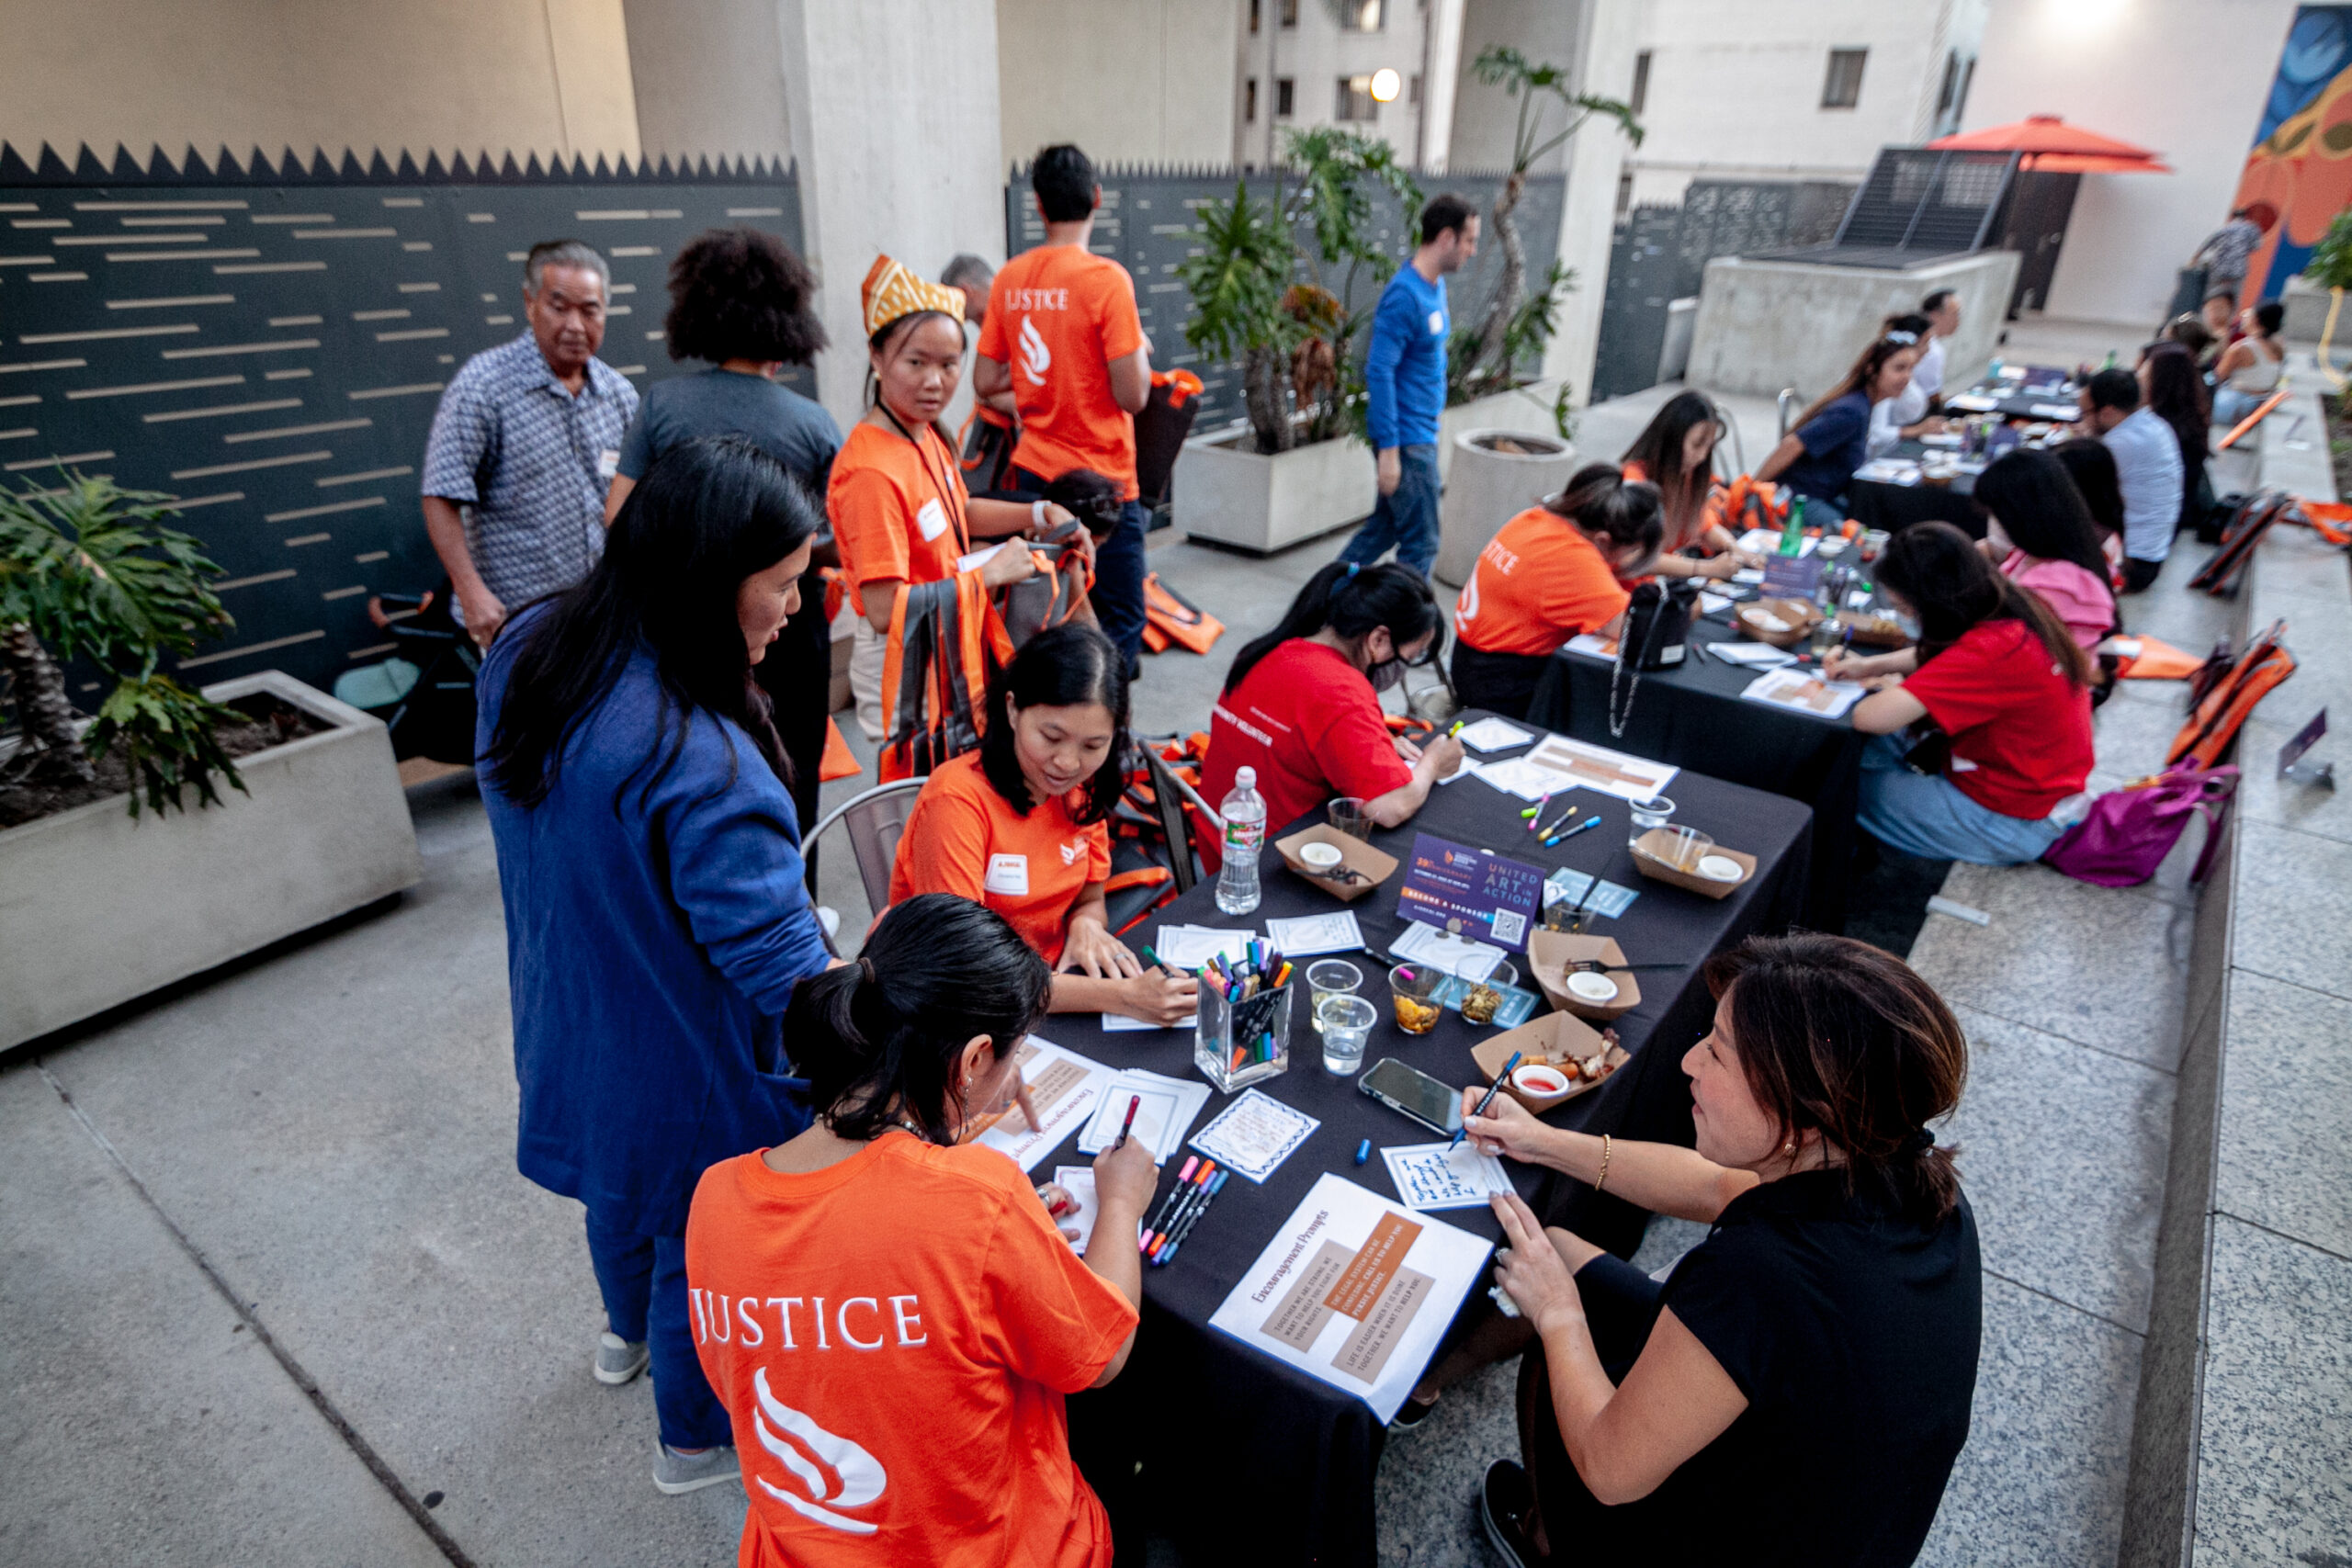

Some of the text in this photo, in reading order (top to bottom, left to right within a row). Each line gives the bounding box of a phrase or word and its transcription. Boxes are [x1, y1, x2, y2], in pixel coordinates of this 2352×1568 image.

[1487, 862, 1538, 885] UNITED
[1485, 872, 1521, 893] ART
[1521, 888, 1532, 897] IN
[1482, 885, 1532, 908] ACTION
[1450, 902, 1487, 919] SPONSOR
[1012, 1133, 1043, 1158] Prompt
[1251, 1210, 1329, 1304] Encouragement Prompts
[1390, 1280, 1407, 1295] DONE
[1398, 1290, 1414, 1305] HELP
[1272, 1303, 1297, 1331] TOGETHER
[1293, 1294, 1304, 1304] WE
[1283, 1319, 1299, 1337] WANT
[1295, 1312, 1305, 1320] TO
[1300, 1298, 1315, 1313] HELP
[1372, 1307, 1388, 1325] WHEN
[1393, 1303, 1404, 1313] TO
[689, 1288, 928, 1350] JUSTICE
[1383, 1312, 1399, 1329] WANT
[1358, 1324, 1378, 1346] EASIER
[1376, 1328, 1388, 1339] WE
[1354, 1344, 1364, 1352] IS
[1345, 1351, 1361, 1367] LIFE
